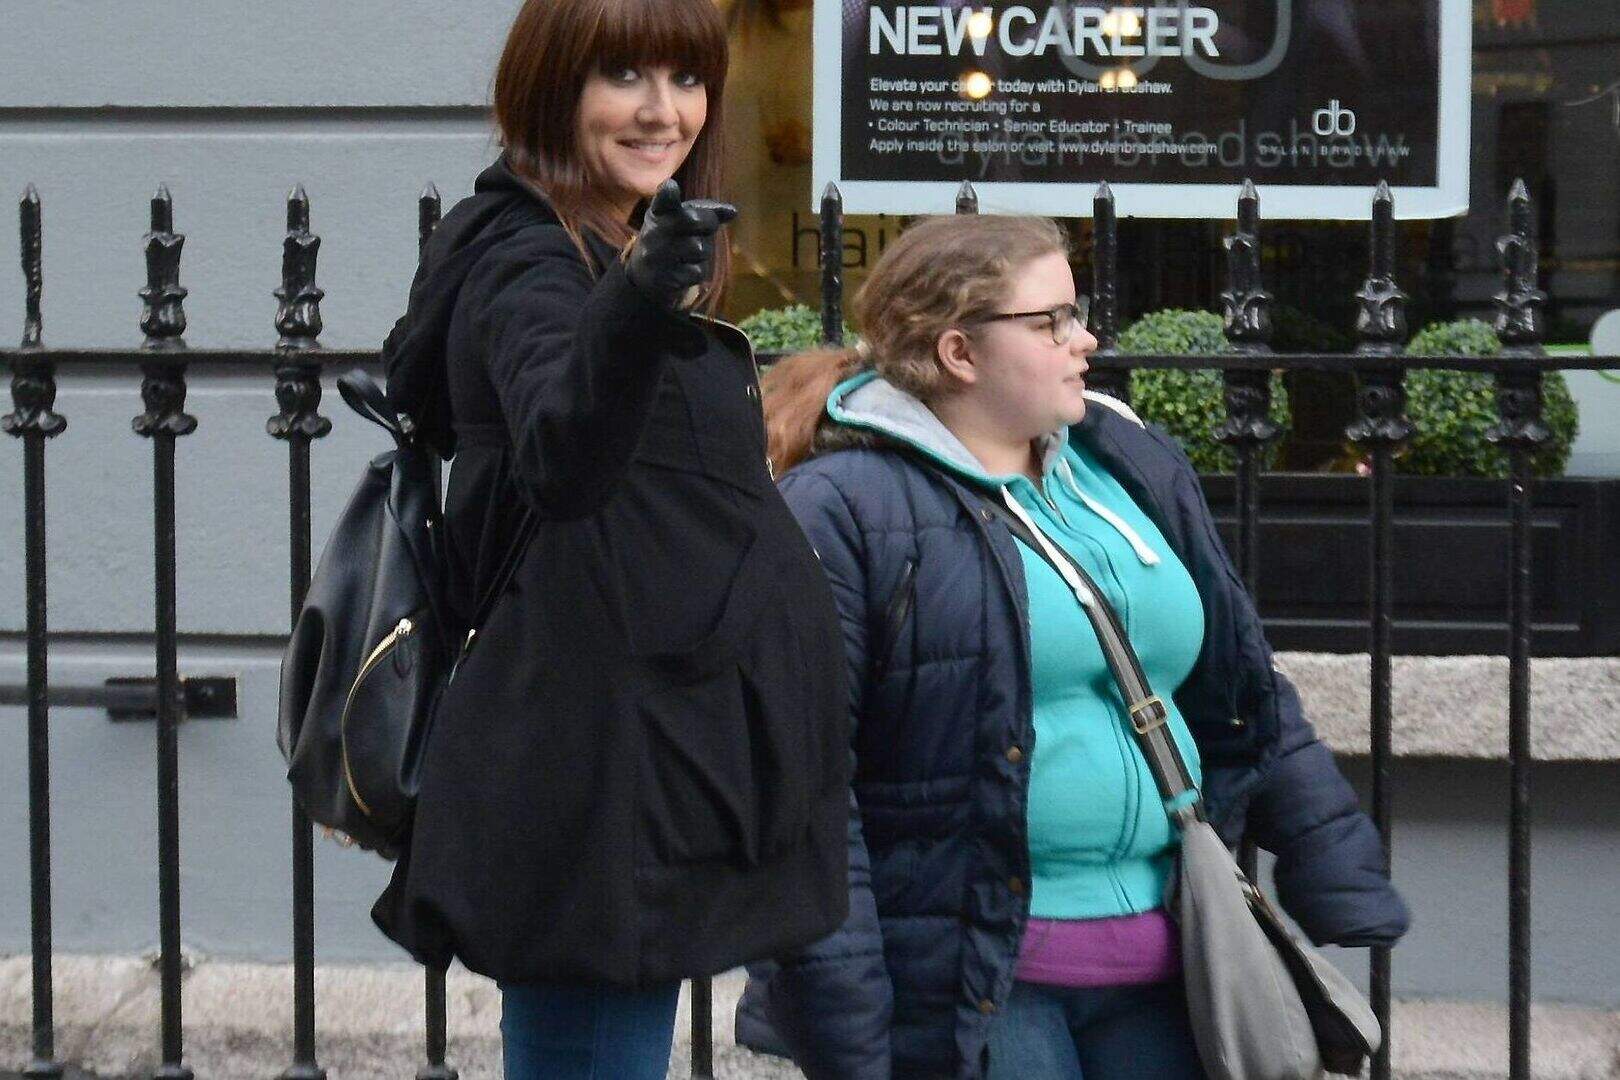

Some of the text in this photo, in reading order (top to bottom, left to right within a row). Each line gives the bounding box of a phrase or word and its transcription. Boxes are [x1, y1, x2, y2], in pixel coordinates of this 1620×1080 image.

[869, 6, 993, 56] NEW
[998, 6, 1220, 56] CAREER
[870, 77, 917, 92] Elevate
[920, 80, 949, 94] your
[998, 79, 1034, 95] today
[1038, 79, 1065, 93] with
[1068, 79, 1102, 95] Dylan
[870, 98, 1041, 115] We are now recruiting for a
[878, 119, 1172, 133] Colour Technician Senior Educator Trainee
[869, 138, 1217, 156] Apply inside the salon or visit www.dylanbradshaw.com
